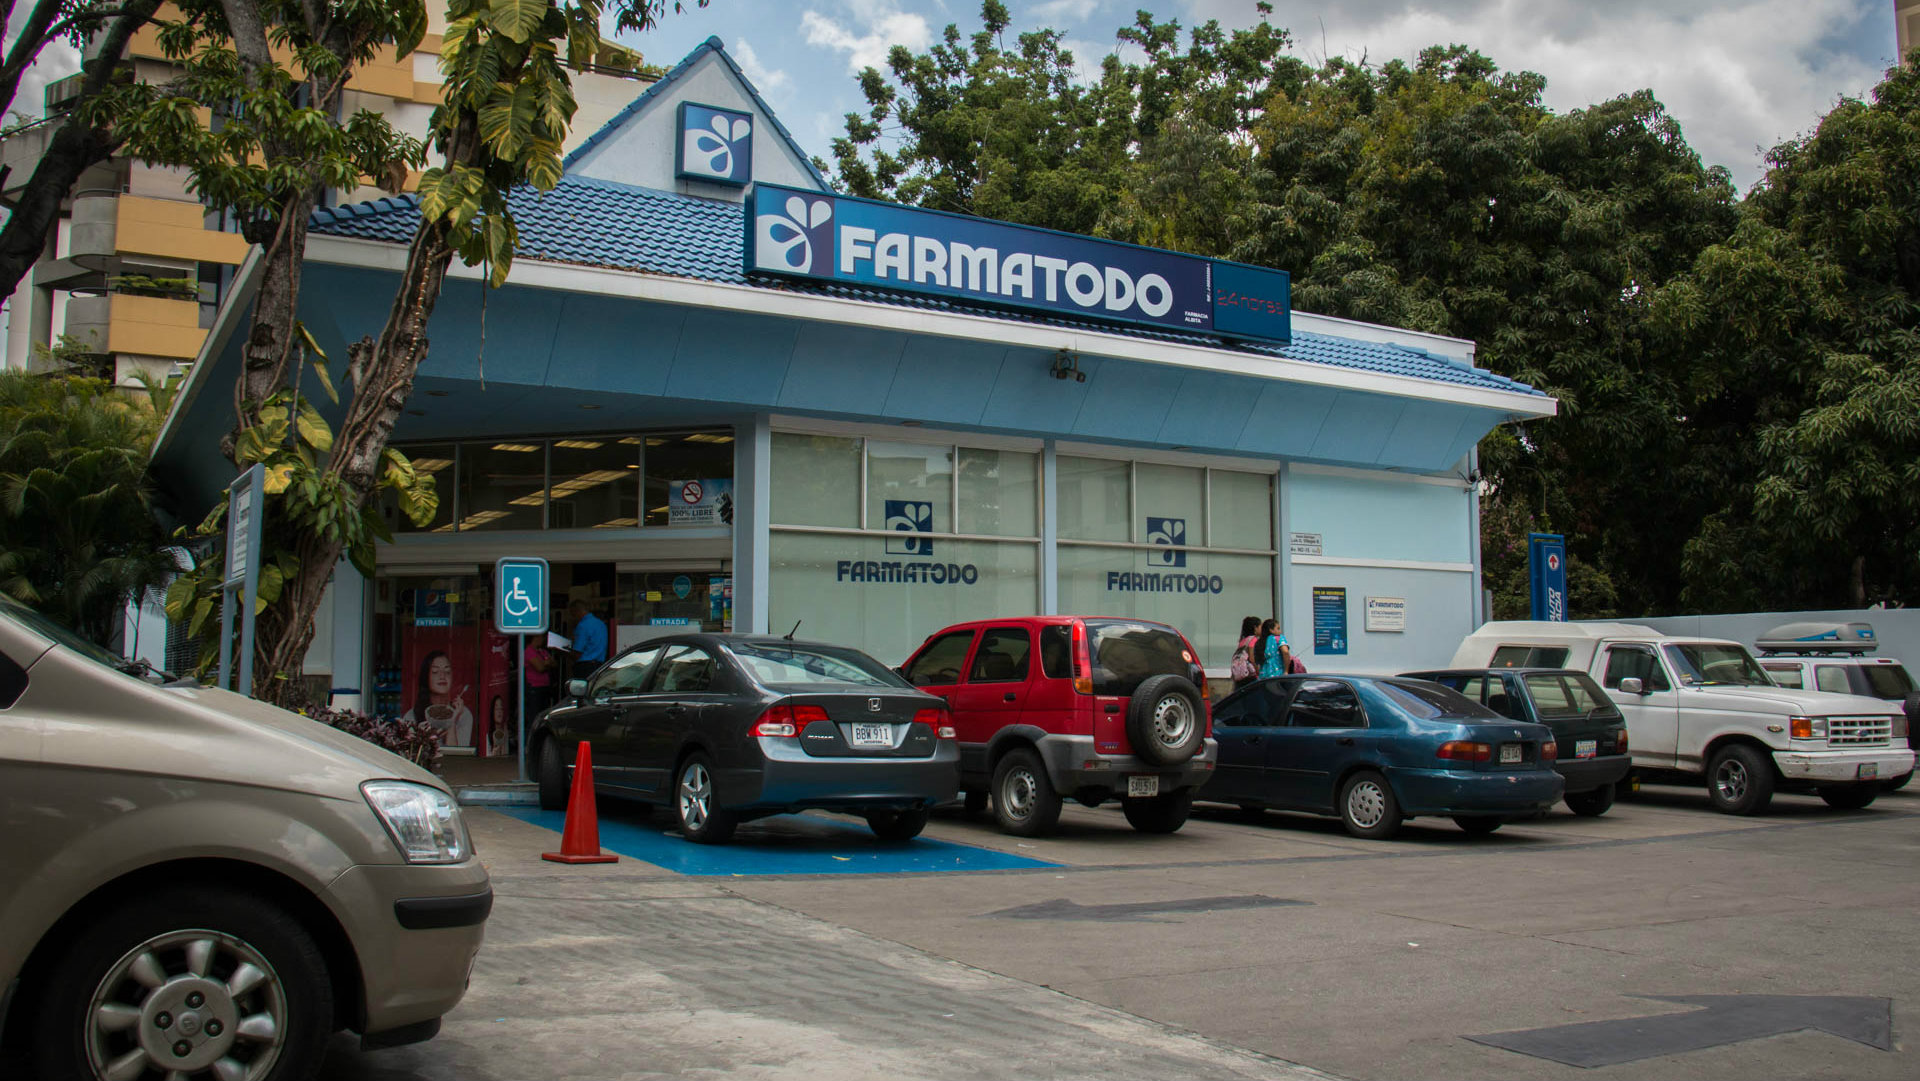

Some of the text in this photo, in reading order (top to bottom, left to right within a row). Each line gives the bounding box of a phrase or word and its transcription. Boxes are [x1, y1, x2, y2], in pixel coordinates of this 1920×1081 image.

[840, 224, 1174, 317] FARMATODO
[1184, 310, 1209, 319] FARMACIA
[837, 560, 978, 585] FARMATODO
[1107, 571, 1223, 594] FARMATODO
[1375, 601, 1404, 609] FARMATODO
[1548, 587, 1556, 621] AUTO
[855, 727, 889, 740] BBW 911
